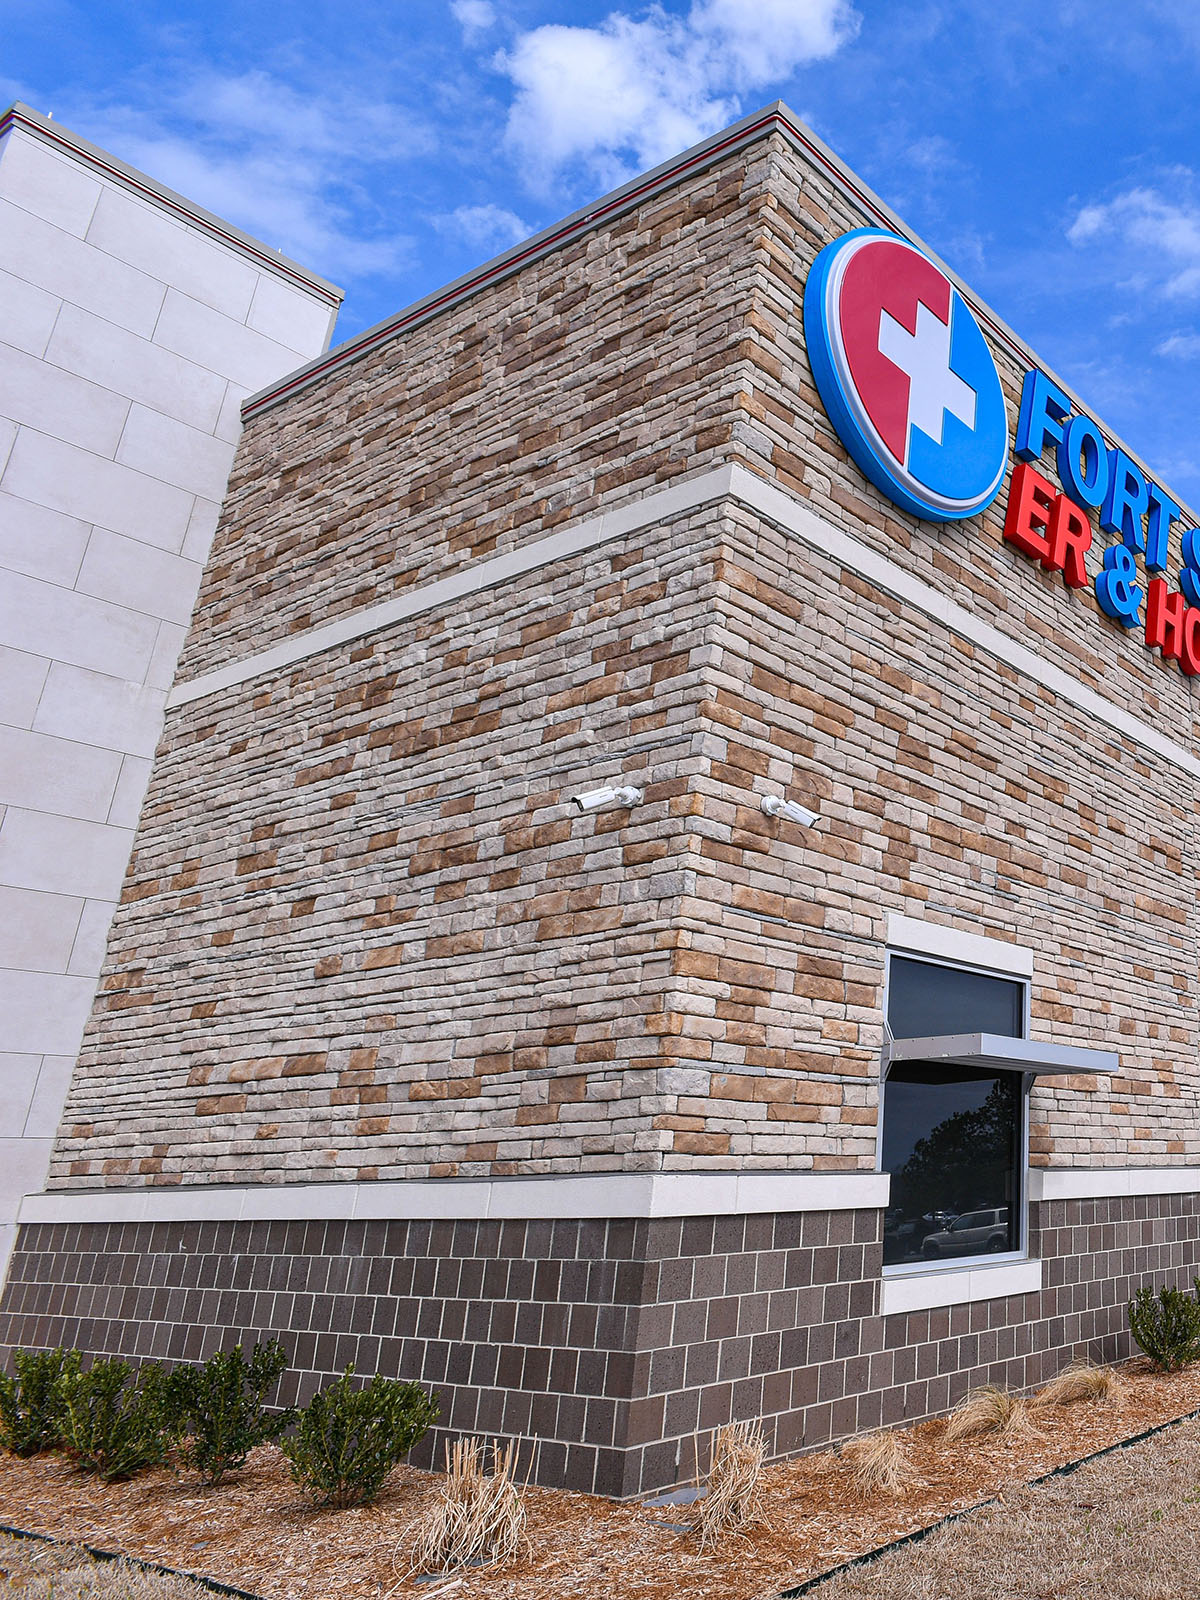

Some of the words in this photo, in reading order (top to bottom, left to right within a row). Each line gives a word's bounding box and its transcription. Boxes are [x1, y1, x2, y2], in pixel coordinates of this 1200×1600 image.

[1003, 462, 1092, 588] ER
[1095, 544, 1143, 628] &
[1015, 368, 1181, 572] FORT
